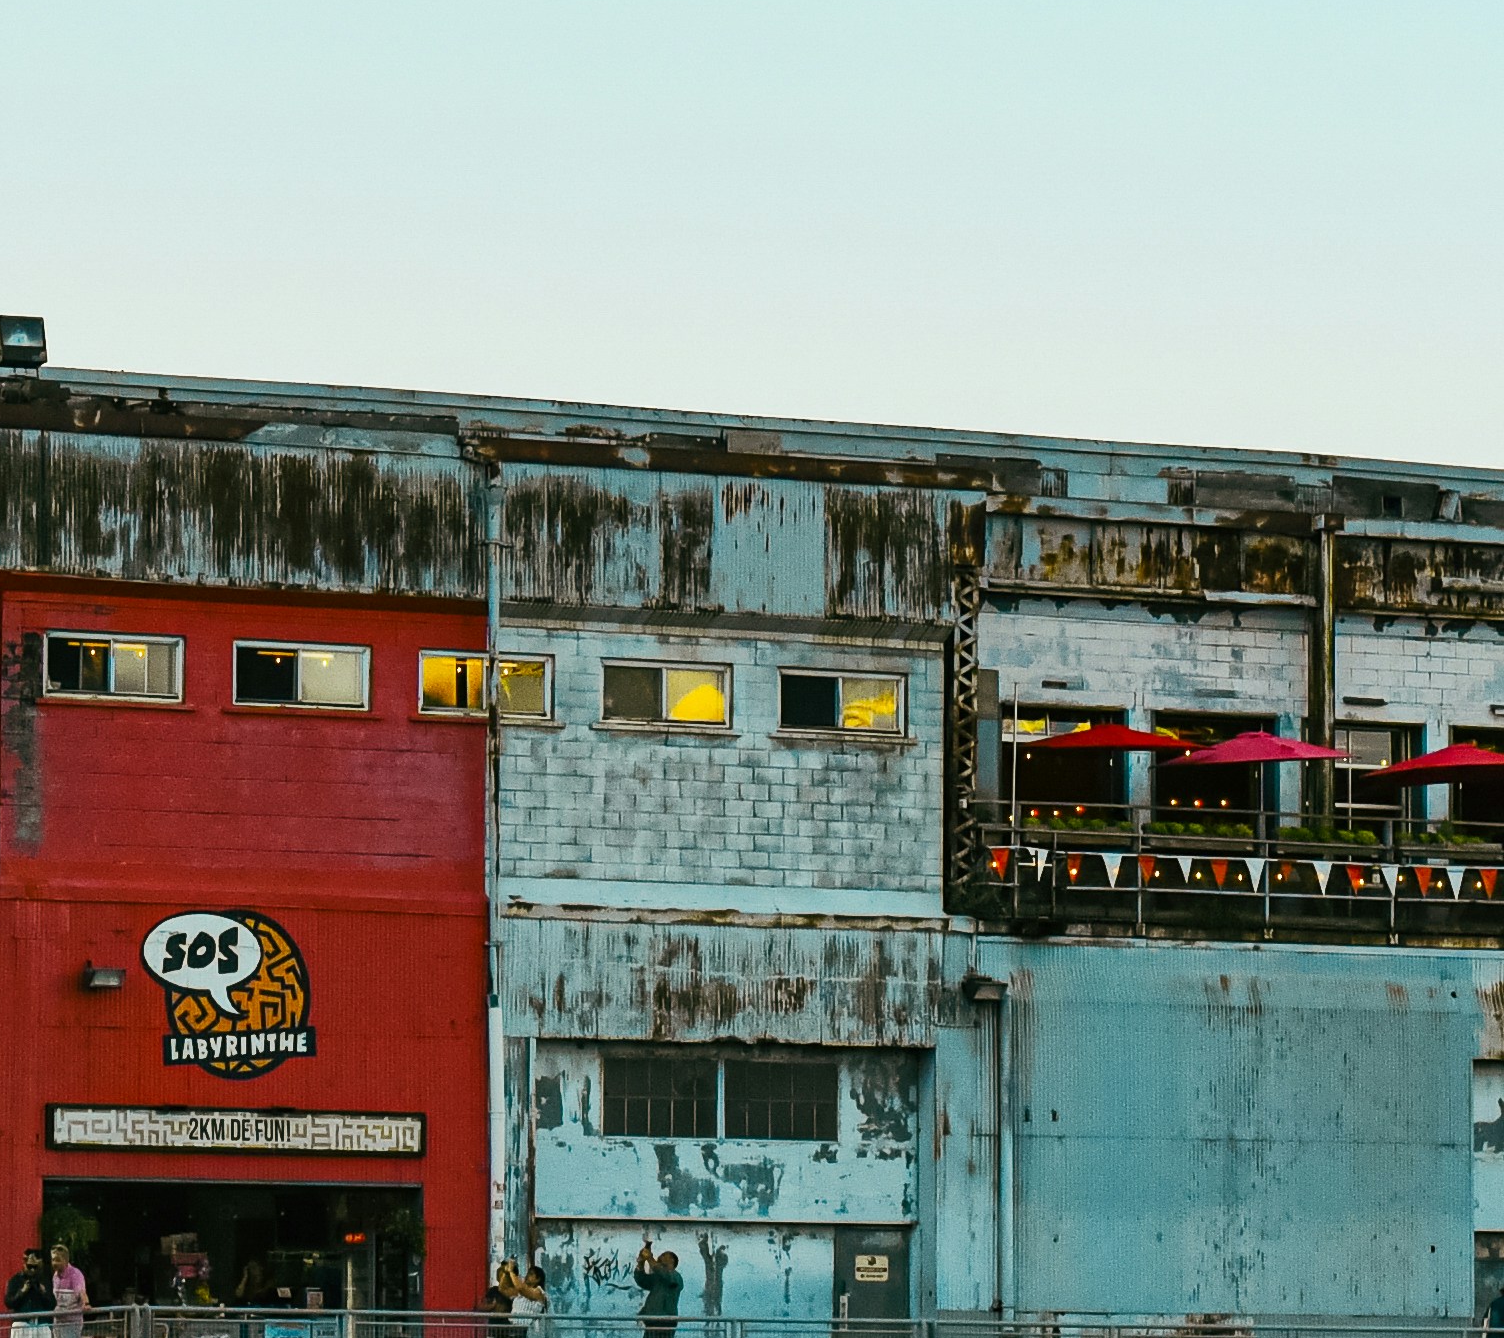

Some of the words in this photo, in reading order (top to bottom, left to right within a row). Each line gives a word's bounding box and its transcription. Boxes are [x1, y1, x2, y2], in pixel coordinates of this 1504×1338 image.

[162, 927, 238, 974] SOS
[170, 1032, 307, 1060] LABYRINTHE
[188, 1117, 225, 1141] 2KM
[230, 1119, 251, 1142] DE
[254, 1119, 291, 1143] FUN!
